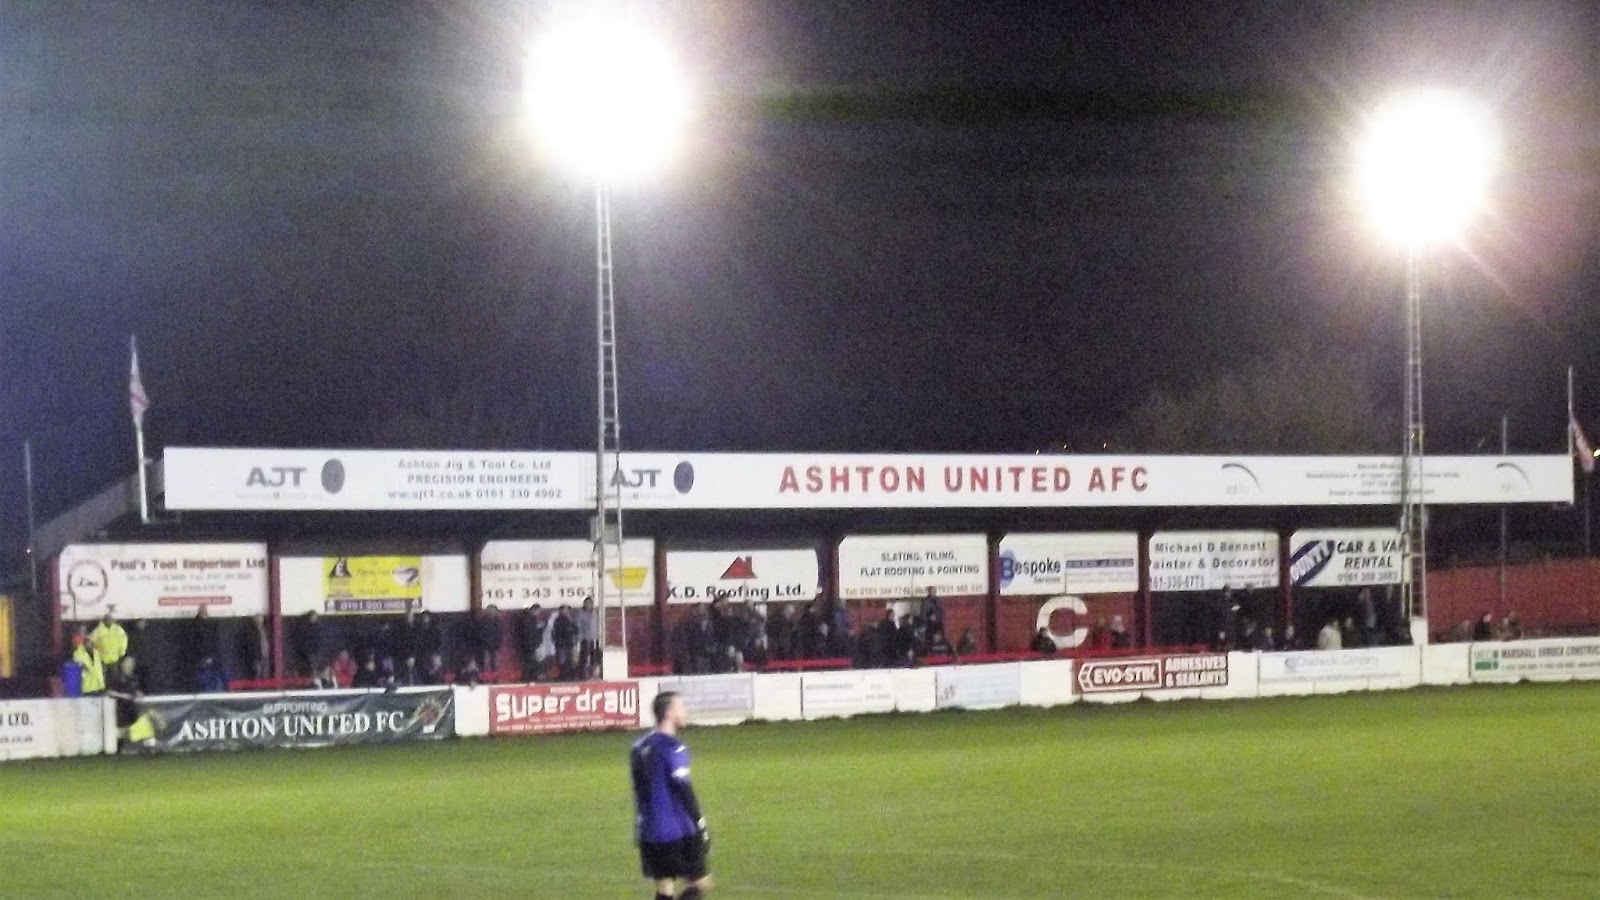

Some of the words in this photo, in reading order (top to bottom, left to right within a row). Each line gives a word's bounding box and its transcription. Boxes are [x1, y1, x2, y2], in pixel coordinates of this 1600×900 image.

[398, 459, 441, 469] Ashton
[444, 459, 463, 471] Jig
[467, 460, 476, 469] &
[481, 459, 506, 469] Tool
[532, 459, 552, 470] Ltd
[246, 467, 307, 487] AJT
[407, 474, 475, 484] PRECISION
[479, 474, 548, 484] ENGINEERS
[609, 469, 662, 488] AJT
[778, 466, 926, 494] ASHTON
[943, 466, 1071, 493] UNITED
[1088, 466, 1149, 493] AFC
[476, 488, 504, 499] 0161
[1155, 542, 1202, 553] Michael
[1207, 542, 1215, 553] D
[1220, 541, 1267, 553] Bennett
[1337, 541, 1364, 554] CAR
[1368, 540, 1376, 553] &
[110, 558, 147, 570] Paul's
[152, 558, 178, 569] Tool
[183, 557, 241, 571] Emporium
[246, 557, 266, 569] Ltd
[552, 560, 574, 571] SKIP
[999, 556, 1062, 580] Bespoke
[1198, 559, 1206, 569] &
[1212, 557, 1275, 569] Decorator
[1344, 555, 1394, 568] RENTAL
[860, 567, 882, 577] FLAT
[884, 566, 925, 577] ROOFING
[937, 565, 980, 575] POINTING
[705, 585, 770, 599] Roofing
[775, 584, 807, 597] Ltd.
[1165, 655, 1227, 671] ADHESIVES
[1175, 670, 1227, 687] SEALANTS
[263, 702, 328, 715] SUPPORTING
[8, 712, 34, 726] LTD.
[178, 716, 276, 741] ASHTON
[283, 712, 370, 737] UNITED
[376, 711, 405, 733] FC
